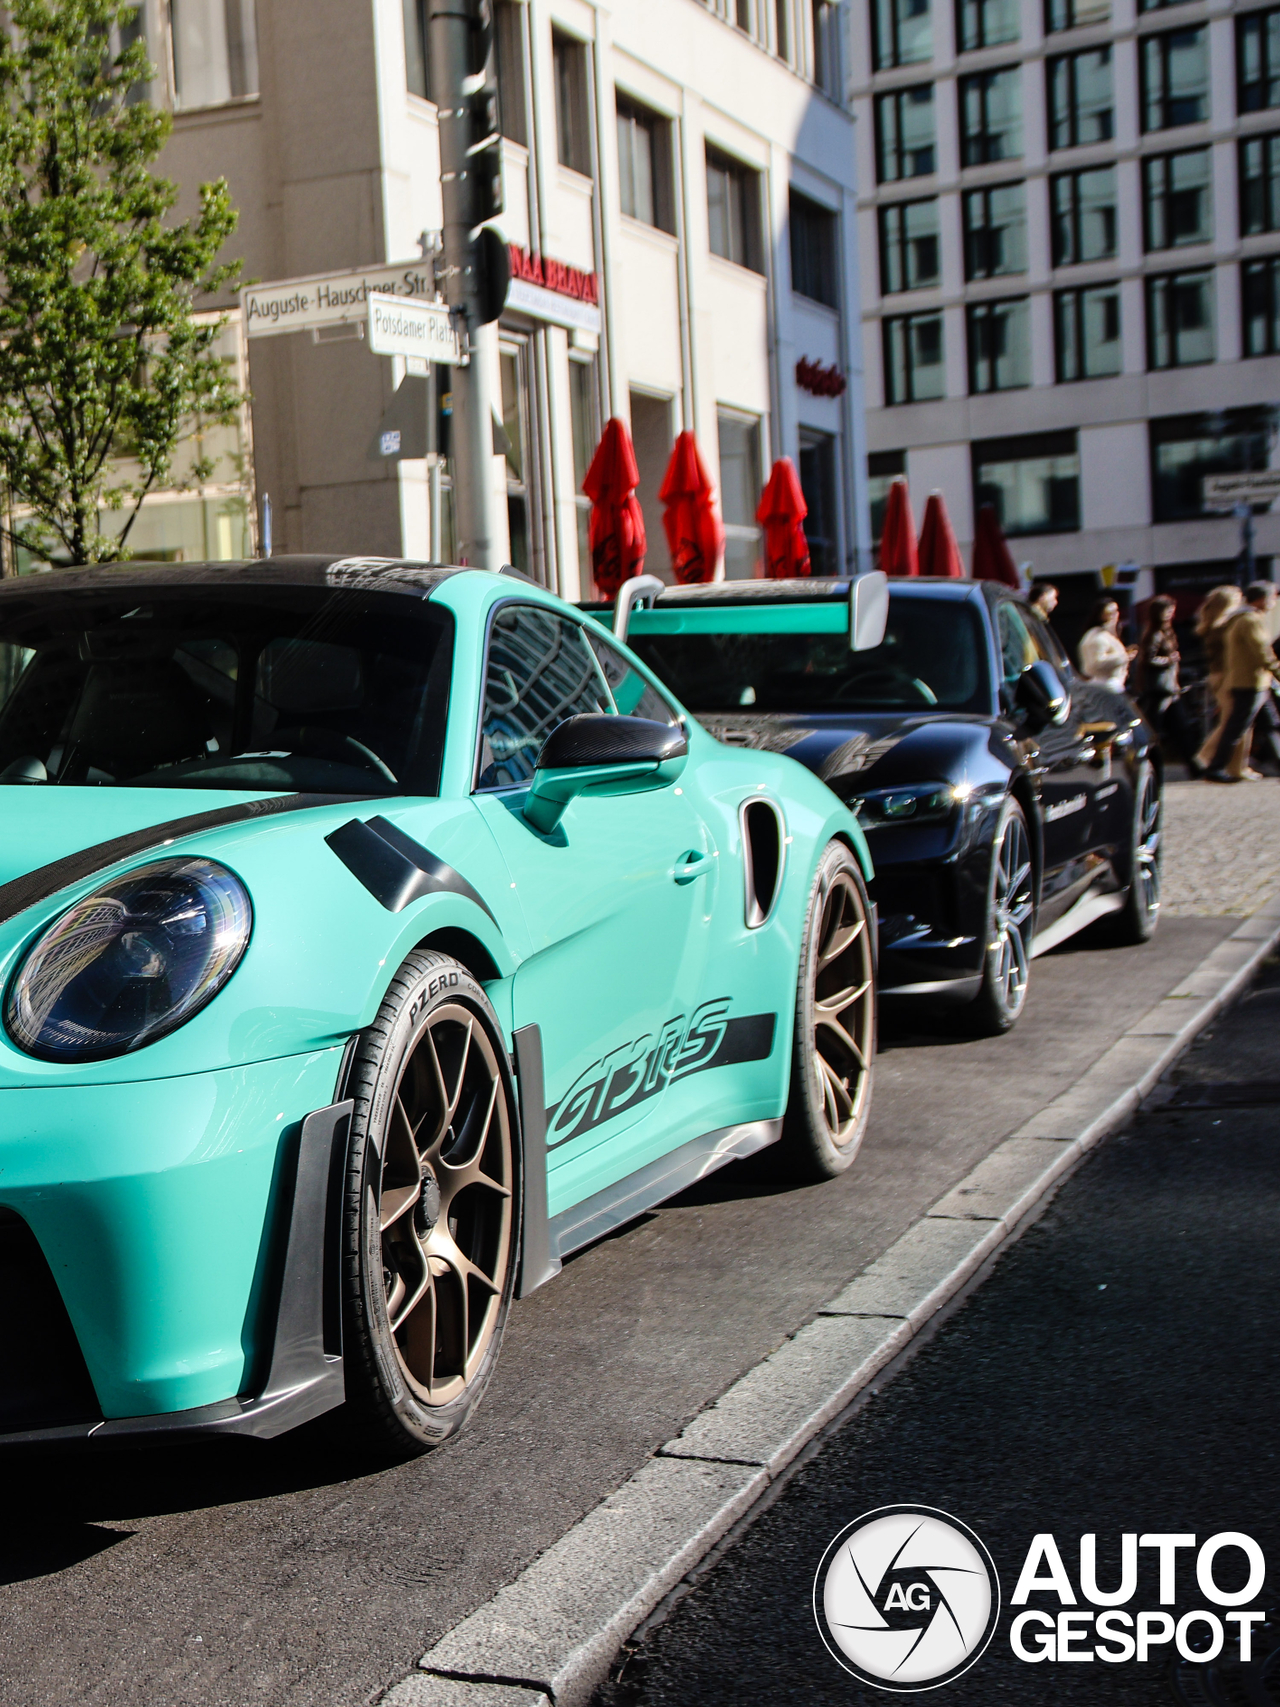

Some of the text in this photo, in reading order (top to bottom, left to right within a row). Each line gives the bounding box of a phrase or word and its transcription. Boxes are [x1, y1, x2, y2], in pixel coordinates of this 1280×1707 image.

[248, 271, 431, 322] Auguste-Hauschner-Str.
[375, 308, 454, 342] Potsdamer Platz
